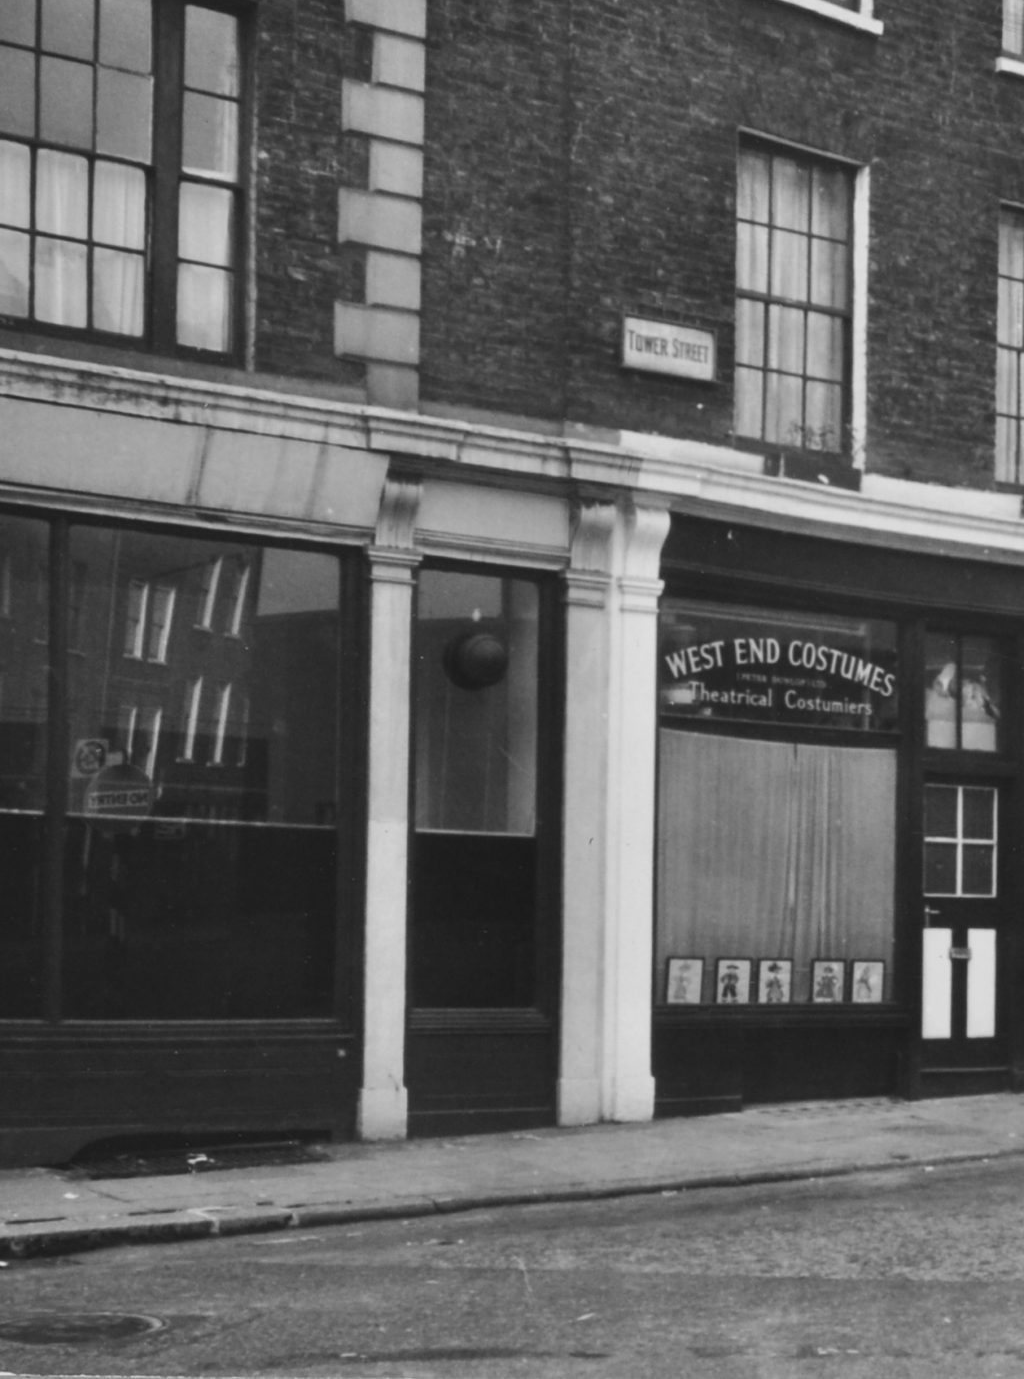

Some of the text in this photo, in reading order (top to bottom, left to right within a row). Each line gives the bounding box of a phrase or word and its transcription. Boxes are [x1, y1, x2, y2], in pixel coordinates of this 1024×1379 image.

[627, 329, 709, 364] TOWER STREET
[664, 637, 896, 697] WEST END COSTUMES
[689, 680, 873, 716] Theatrical Costumiers
